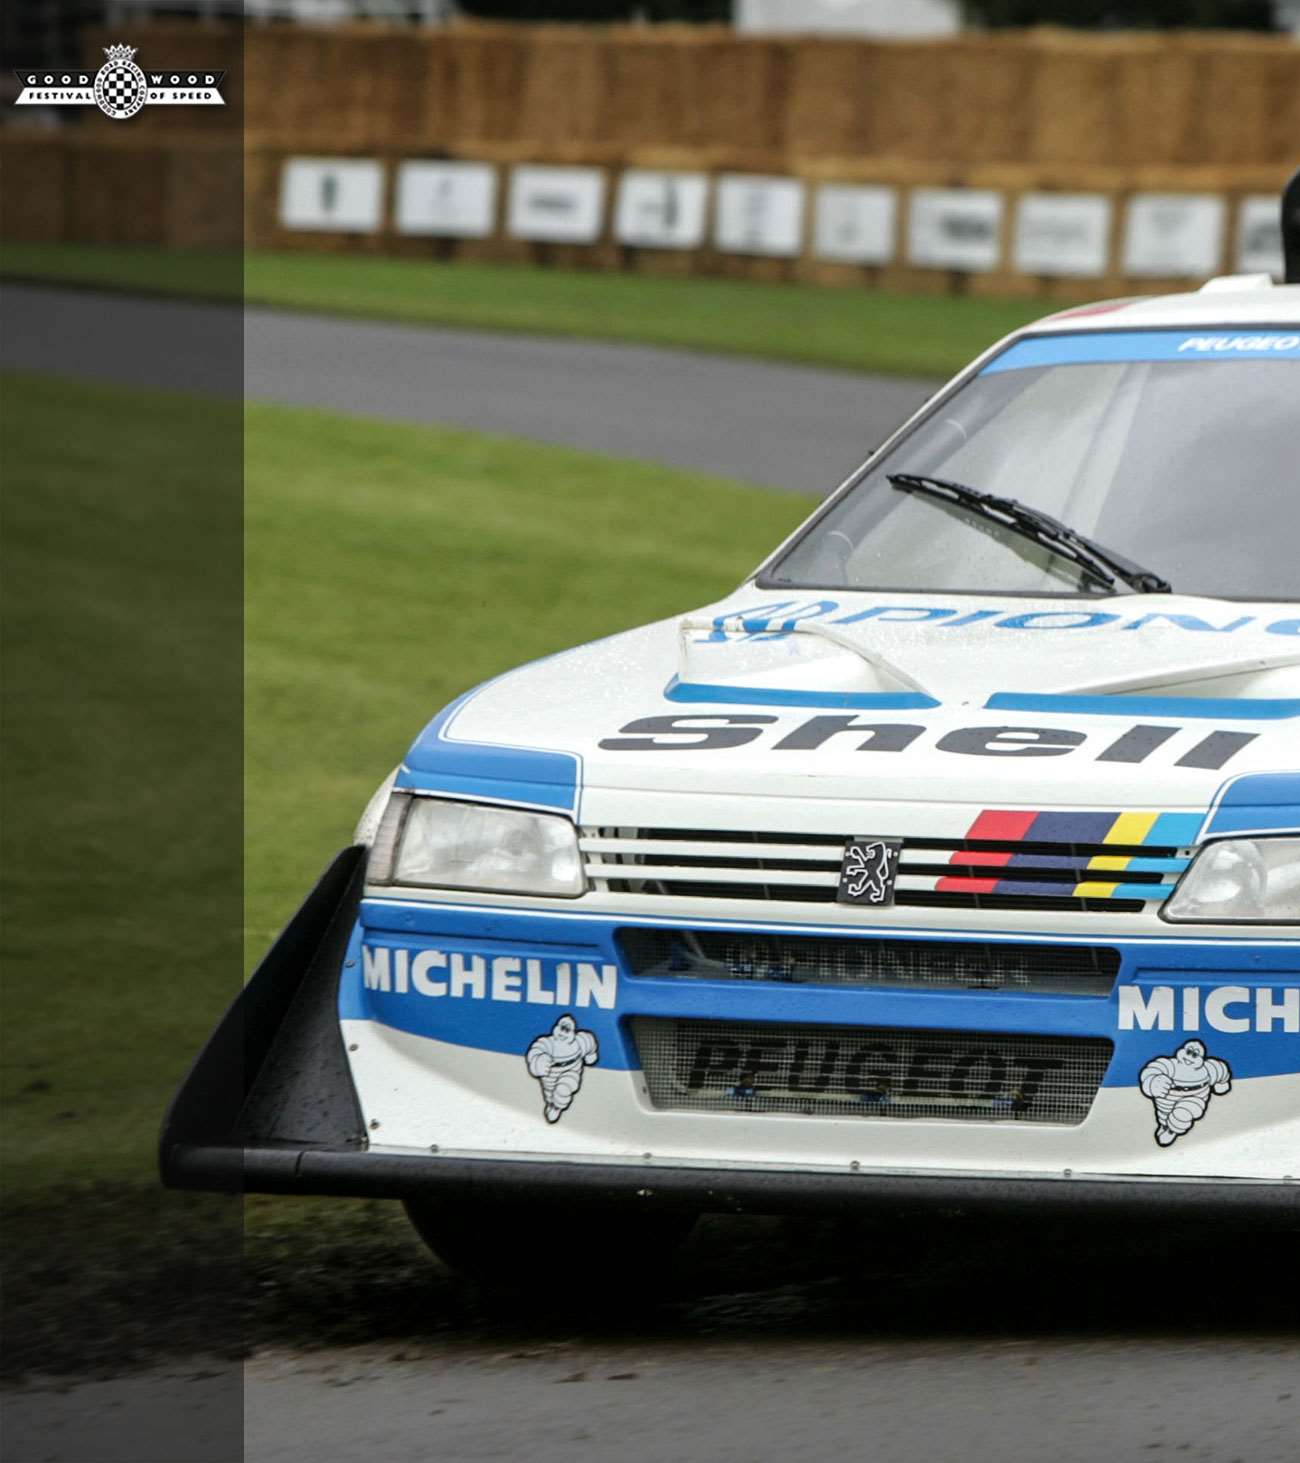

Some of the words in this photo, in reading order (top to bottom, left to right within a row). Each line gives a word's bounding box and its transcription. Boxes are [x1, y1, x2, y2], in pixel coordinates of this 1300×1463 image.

[597, 714, 1262, 771] Shell
[362, 945, 618, 1010] MICHELIN
[687, 1038, 1065, 1108] PEUGEOT
